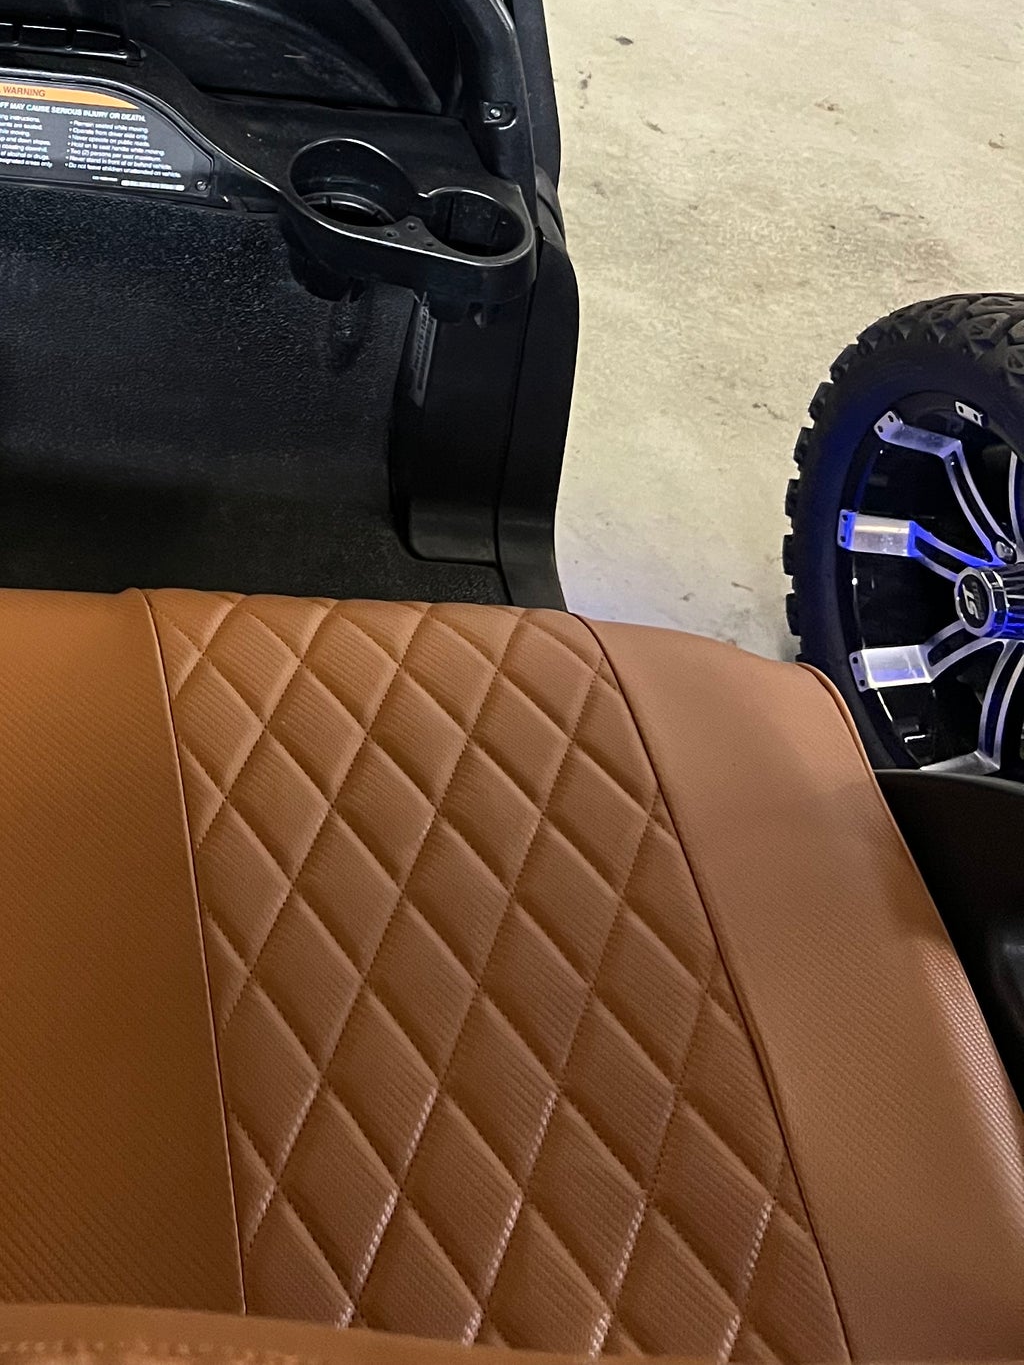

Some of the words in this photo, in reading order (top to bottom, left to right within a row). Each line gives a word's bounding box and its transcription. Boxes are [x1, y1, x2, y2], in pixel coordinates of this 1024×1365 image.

[3, 86, 46, 97] WARNING
[9, 102, 25, 110] MAY
[25, 104, 50, 113] CAUSE
[50, 106, 82, 116] SERIOUS
[82, 109, 108, 117] INJURY
